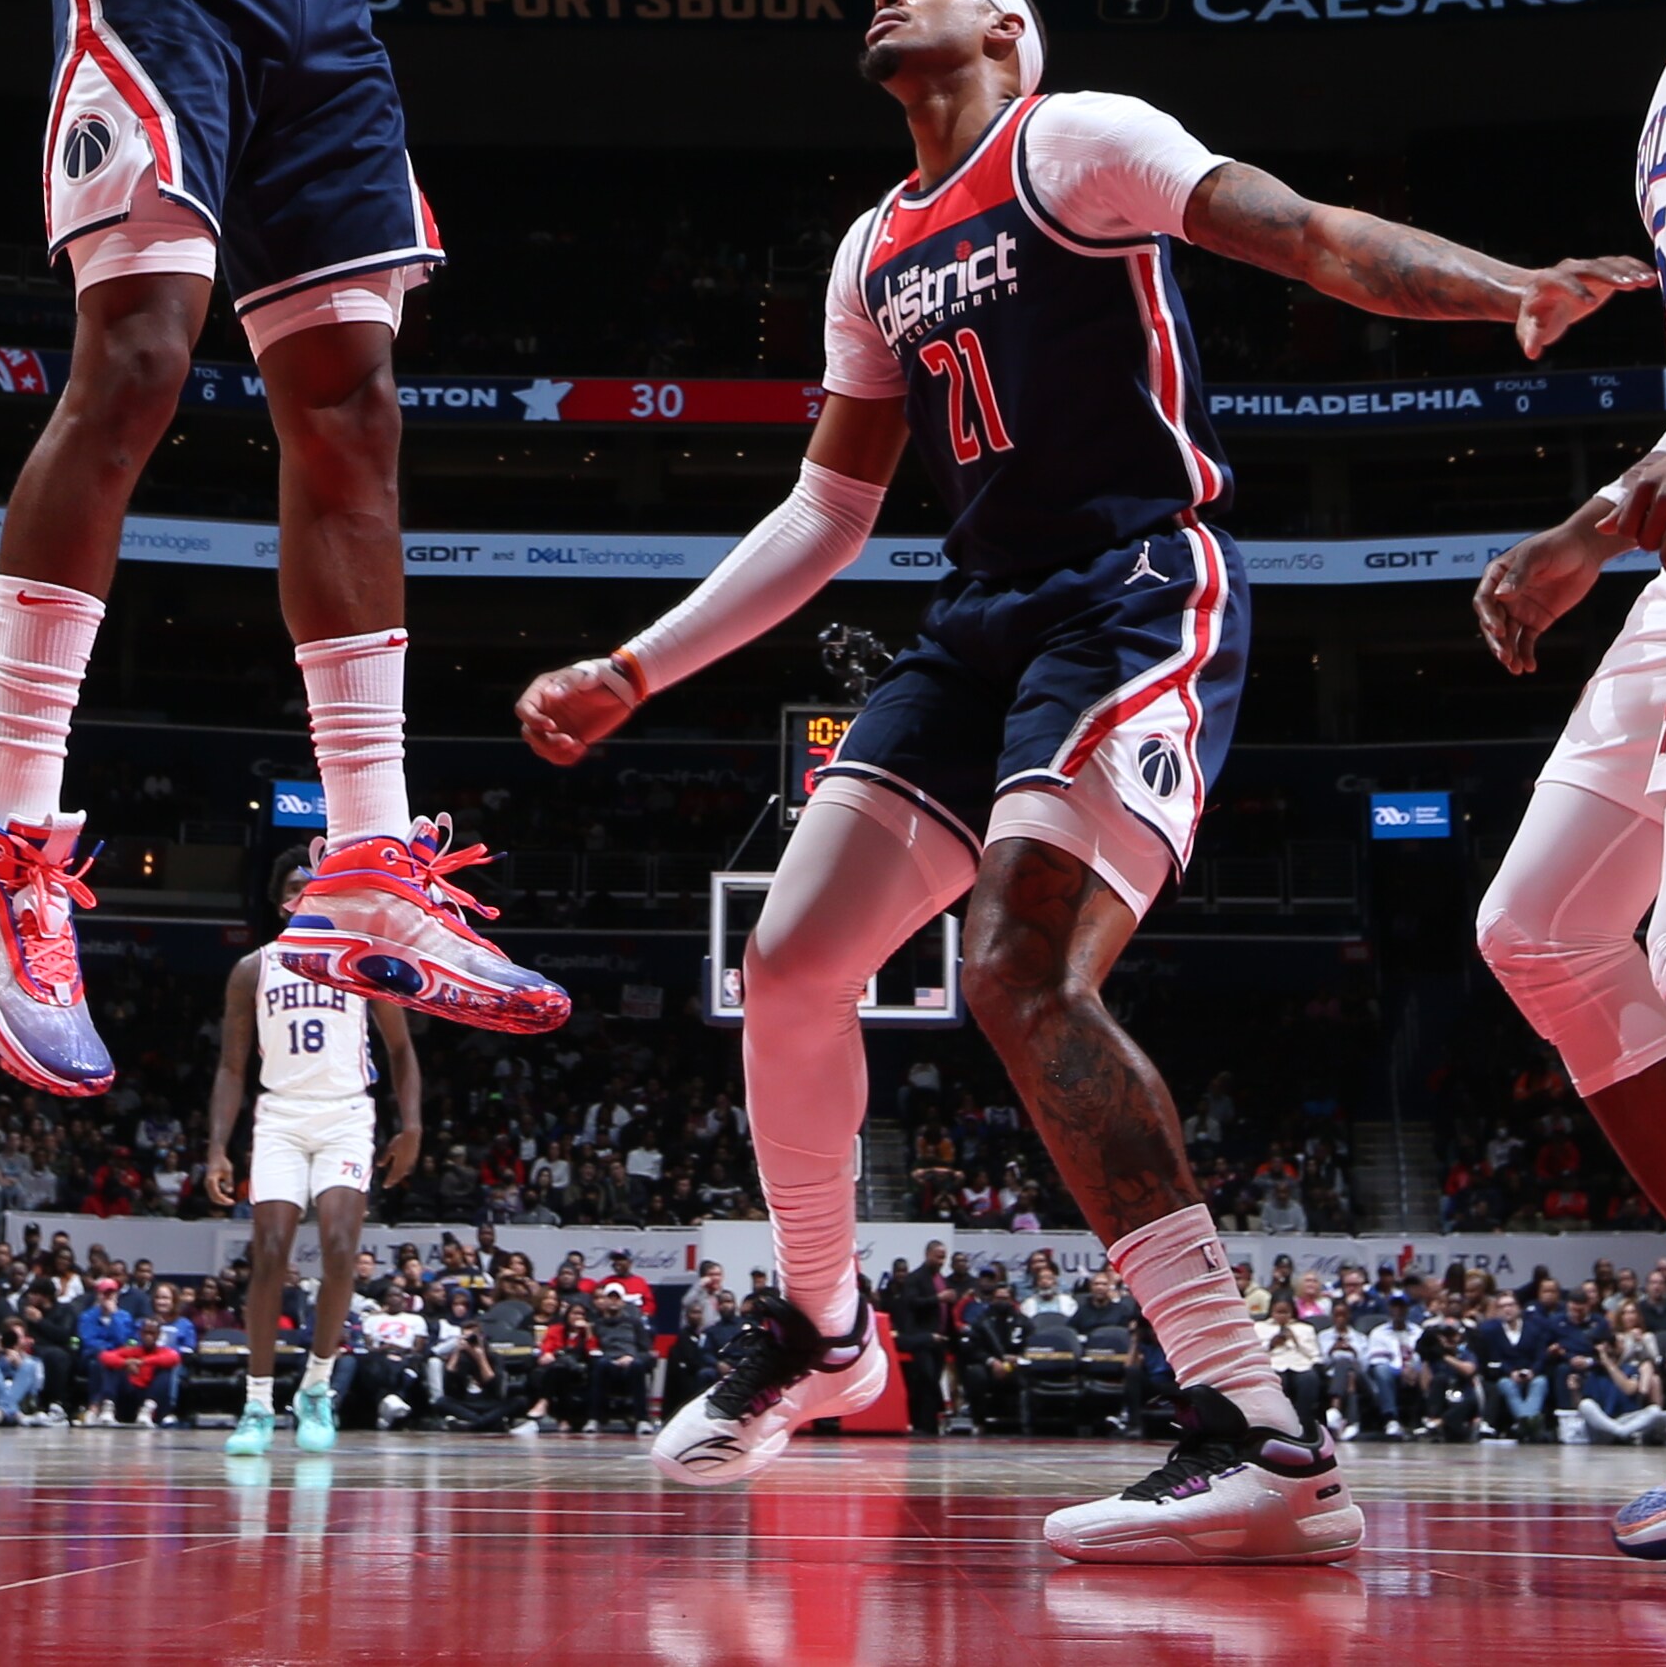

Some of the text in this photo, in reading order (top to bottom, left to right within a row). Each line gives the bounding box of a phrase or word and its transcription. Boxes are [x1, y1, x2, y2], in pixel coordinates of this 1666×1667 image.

[897, 264, 922, 290] THE
[876, 231, 1018, 348] district
[905, 280, 1019, 344] COLUMBIA
[203, 384, 216, 401] 6
[1494, 375, 1621, 393] FOULS TOL
[629, 384, 684, 418] 30
[919, 327, 1015, 466] 21
[1210, 387, 1482, 416] PHILADELPHIA
[1515, 391, 1613, 413] 0 6
[806, 401, 821, 419] 2
[121, 530, 211, 554] chnologies
[406, 546, 685, 569] GDIT and DELL Technologies
[1243, 553, 1324, 570] .com/5G
[1364, 550, 1438, 569] GDIT
[1452, 551, 1475, 564] and
[289, 1019, 325, 1054] 18
[341, 1161, 362, 1179] 76
